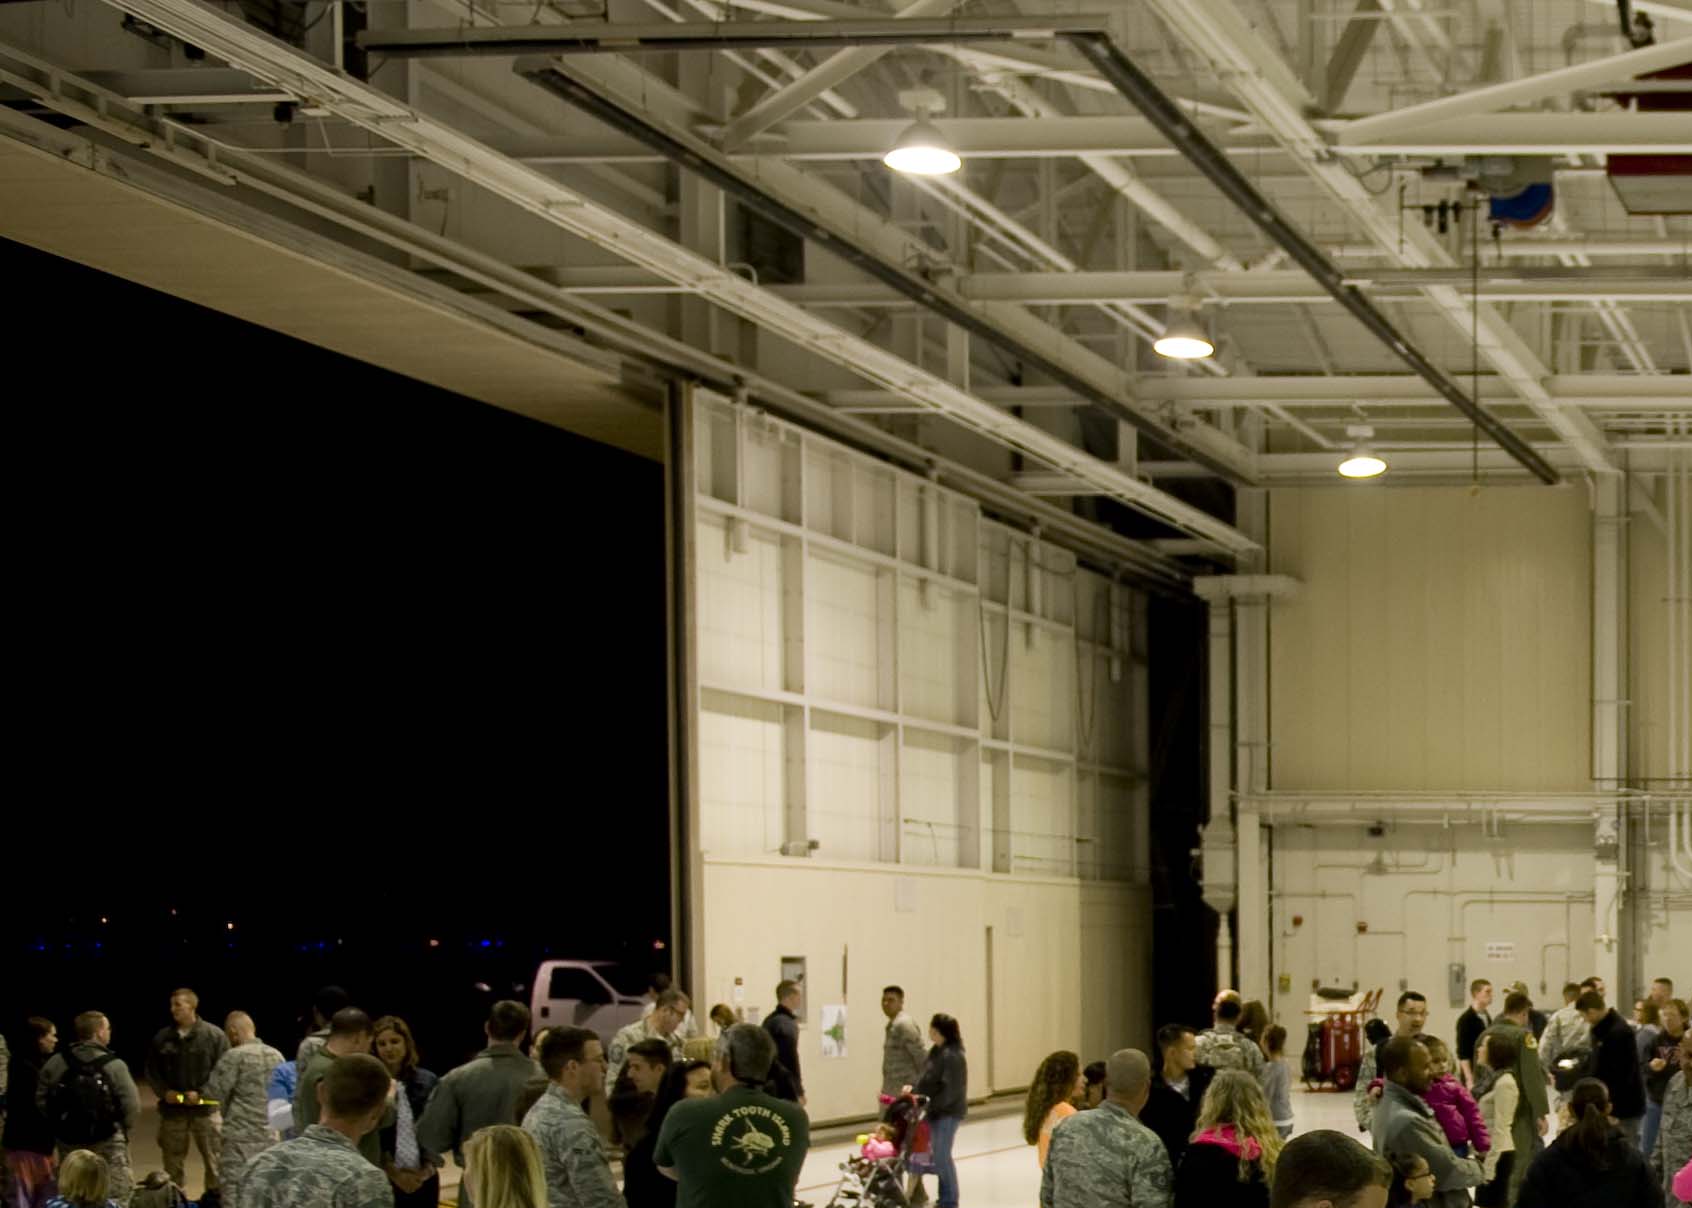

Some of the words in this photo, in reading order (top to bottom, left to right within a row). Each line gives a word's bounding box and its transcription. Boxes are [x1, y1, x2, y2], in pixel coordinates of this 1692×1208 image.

[711, 1113, 734, 1146] SHARK
[732, 1105, 772, 1118] TOOTH
[771, 1113, 791, 1146] ISLAND
